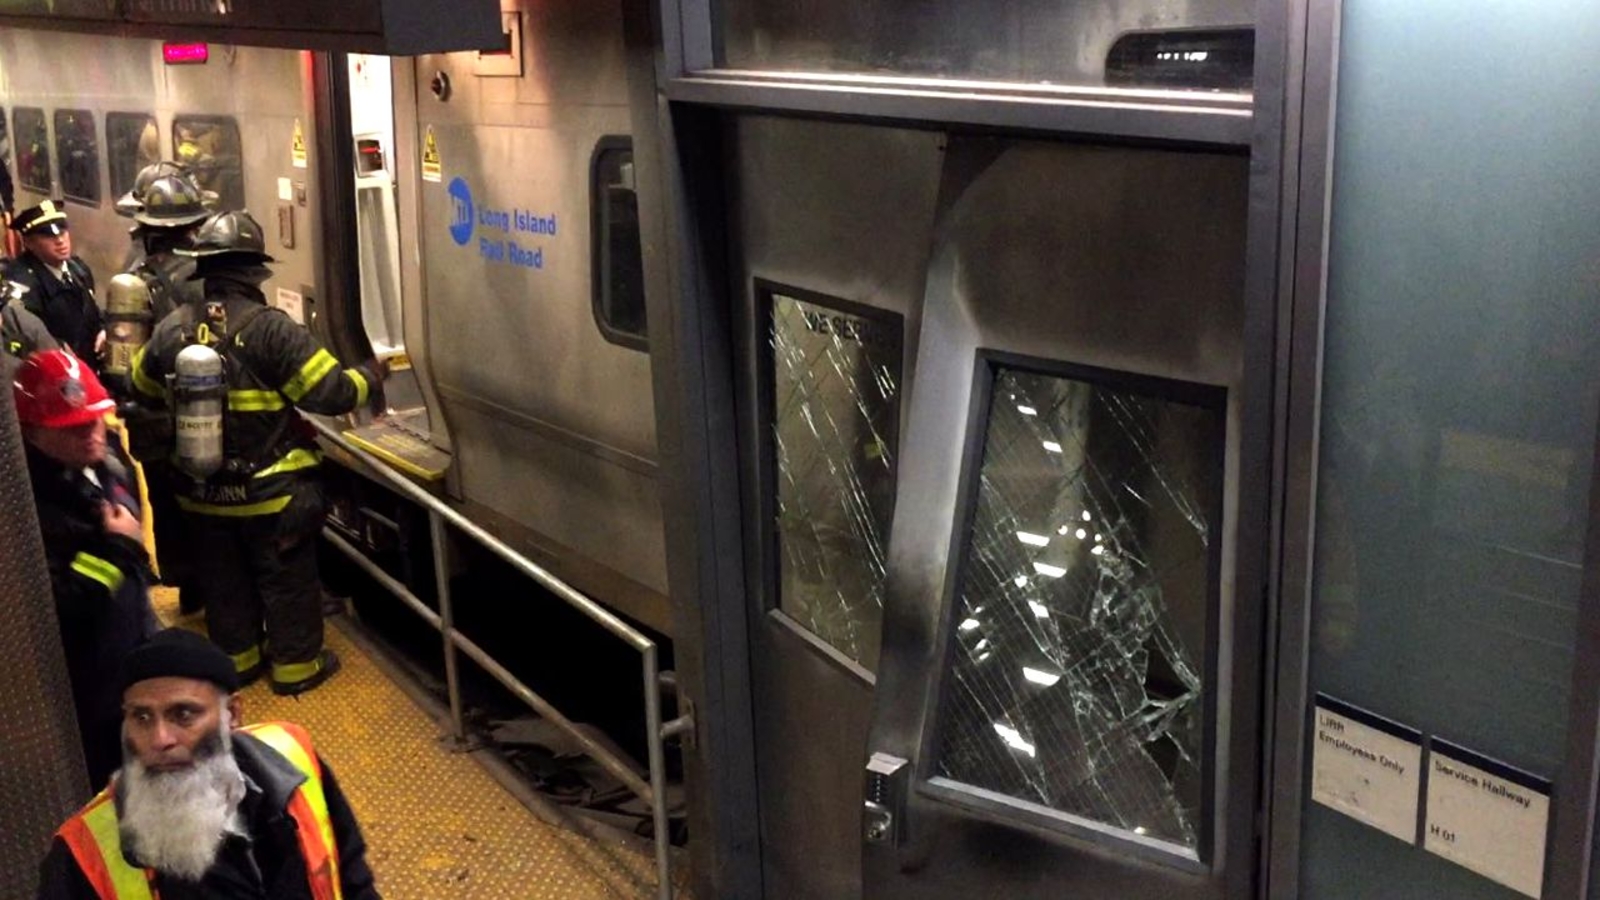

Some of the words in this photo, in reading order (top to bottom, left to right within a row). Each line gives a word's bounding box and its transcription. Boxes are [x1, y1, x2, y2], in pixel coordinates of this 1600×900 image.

[478, 204, 509, 233] Long
[514, 207, 556, 235] Island
[508, 240, 542, 269] Road
[1319, 730, 1376, 761] Employees
[1380, 755, 1405, 775] Only
[1435, 760, 1479, 787] Service
[1482, 779, 1531, 809] Hallway
[1430, 823, 1441, 837] H
[1442, 829, 1456, 842] 01
